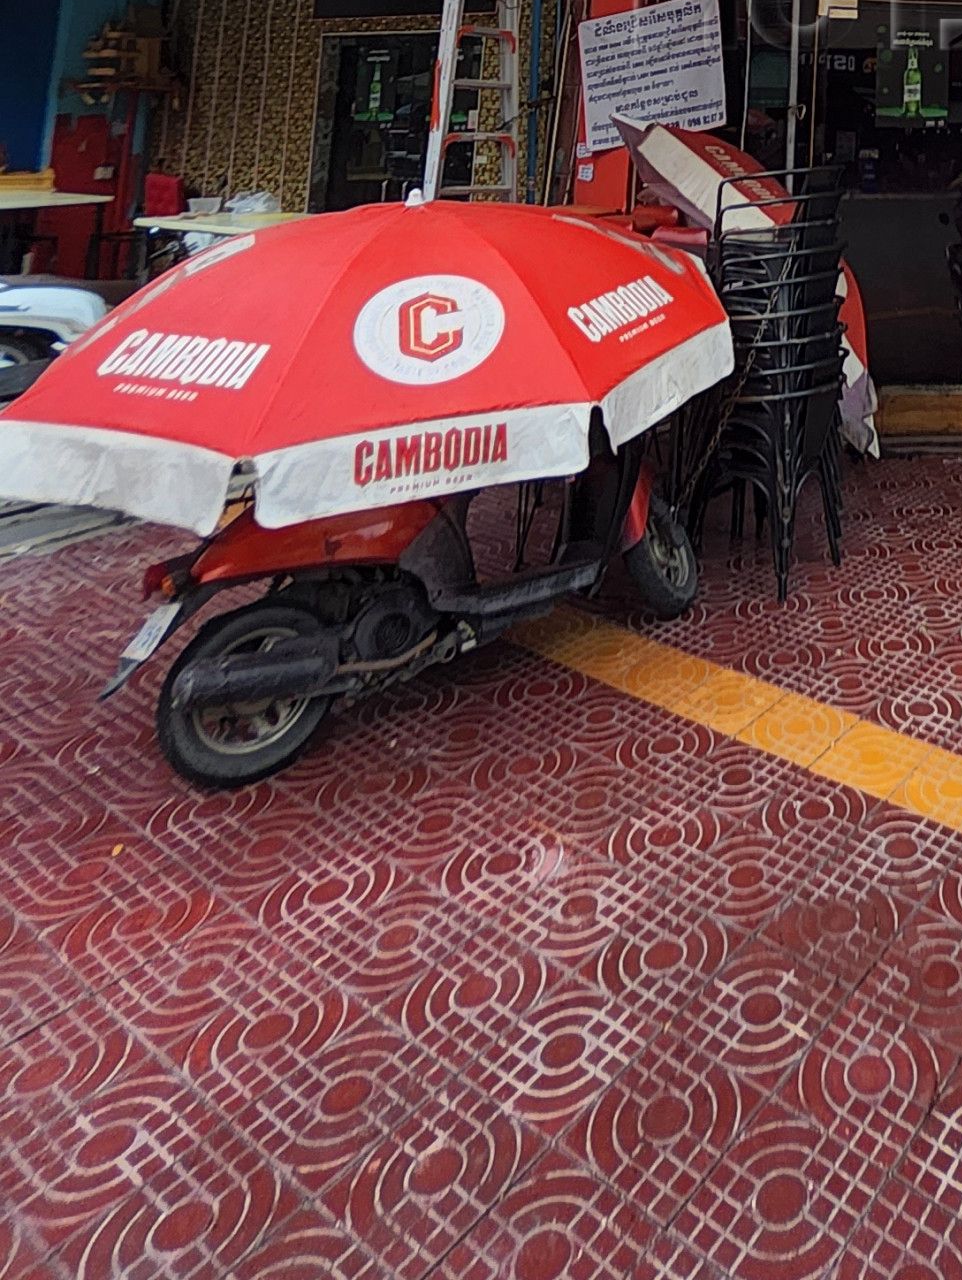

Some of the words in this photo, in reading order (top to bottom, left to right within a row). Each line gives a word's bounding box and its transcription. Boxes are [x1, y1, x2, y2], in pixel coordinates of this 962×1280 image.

[566, 275, 675, 343] CAMBODIA
[618, 321, 650, 343] PREMIUM
[648, 313, 667, 327] BEER
[97, 328, 271, 390] CAMBODIA
[112, 382, 168, 398] PREMIUM
[164, 388, 199, 402] BEER
[354, 422, 508, 488] CAMBODIA
[390, 477, 440, 494] PREMIUM
[445, 473, 474, 485] BEER
